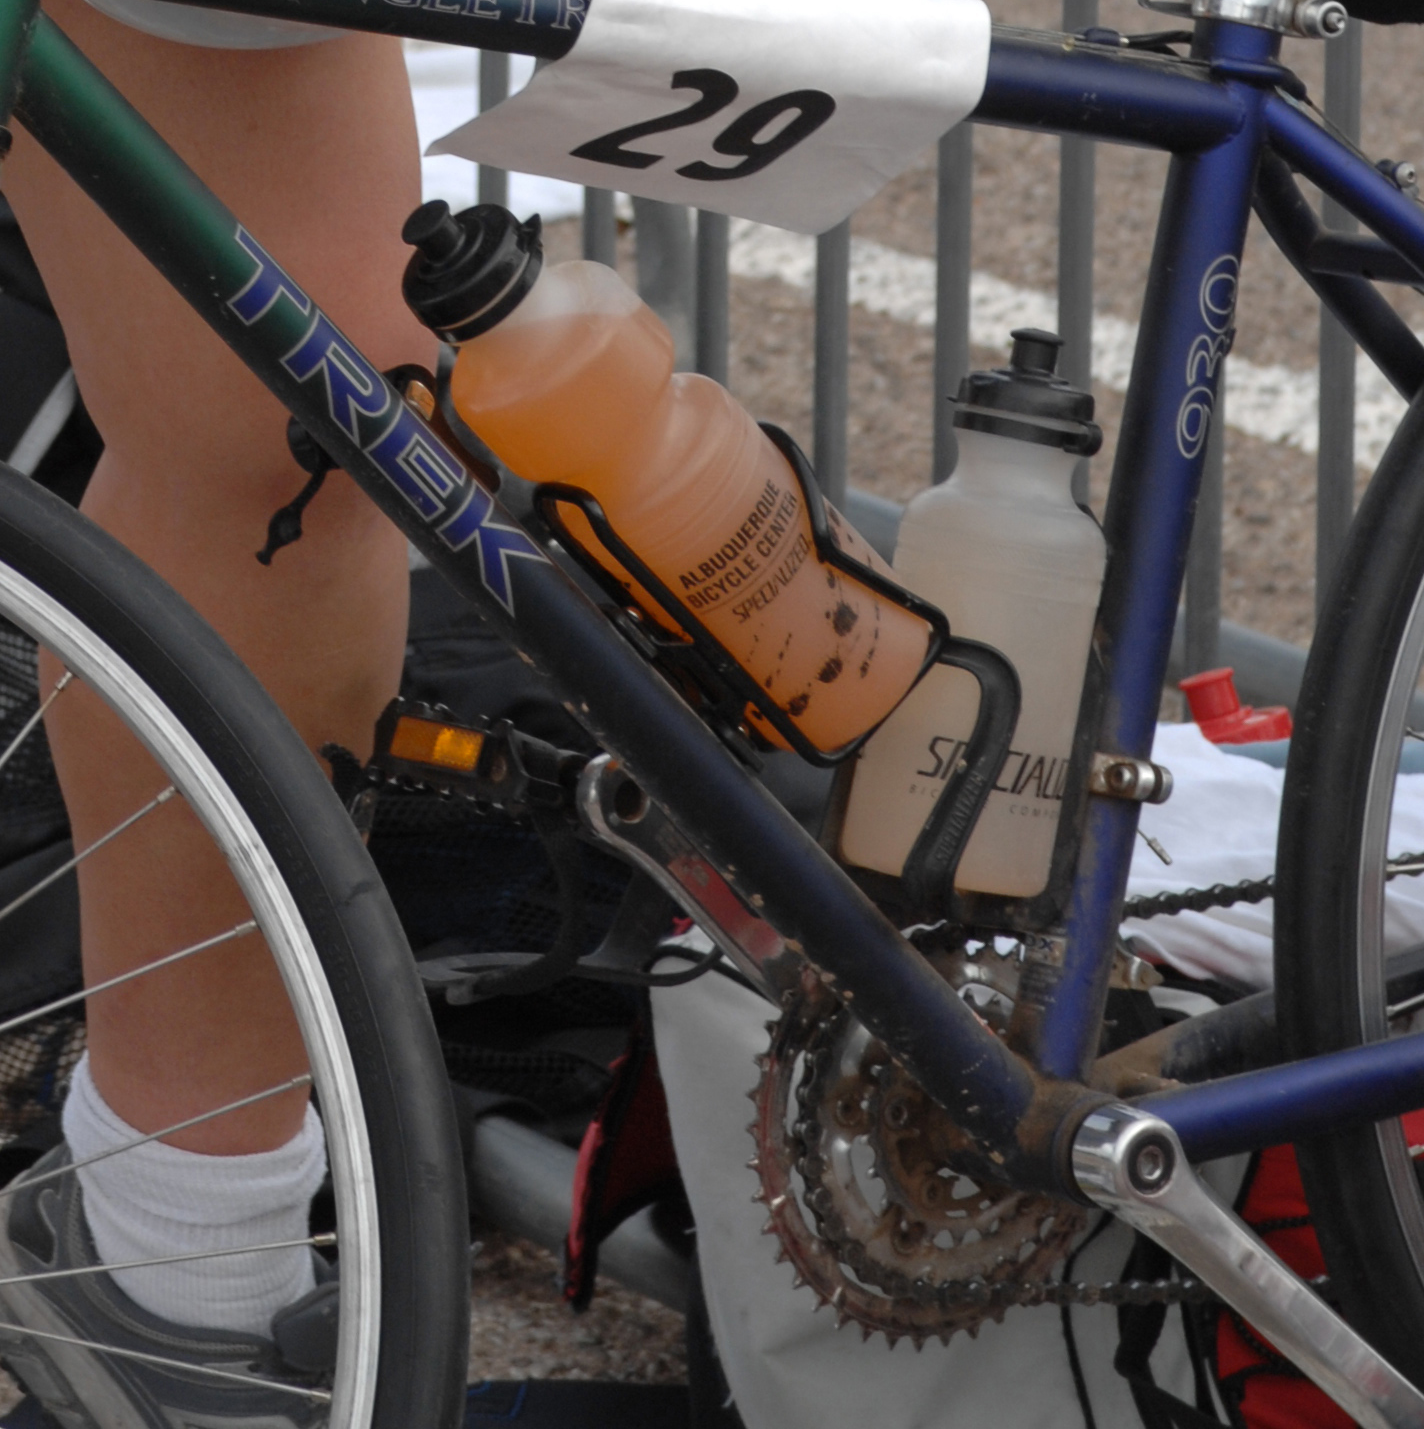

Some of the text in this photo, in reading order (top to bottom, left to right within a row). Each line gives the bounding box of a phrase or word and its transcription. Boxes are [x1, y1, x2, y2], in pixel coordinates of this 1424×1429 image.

[569, 68, 836, 182] 29
[1176, 254, 1240, 459] 930
[226, 222, 554, 619] TREK
[678, 478, 780, 590] ALBUQUERQUE
[686, 491, 798, 609] BICYCLE CENTER
[732, 533, 811, 624] SPECIALIZED
